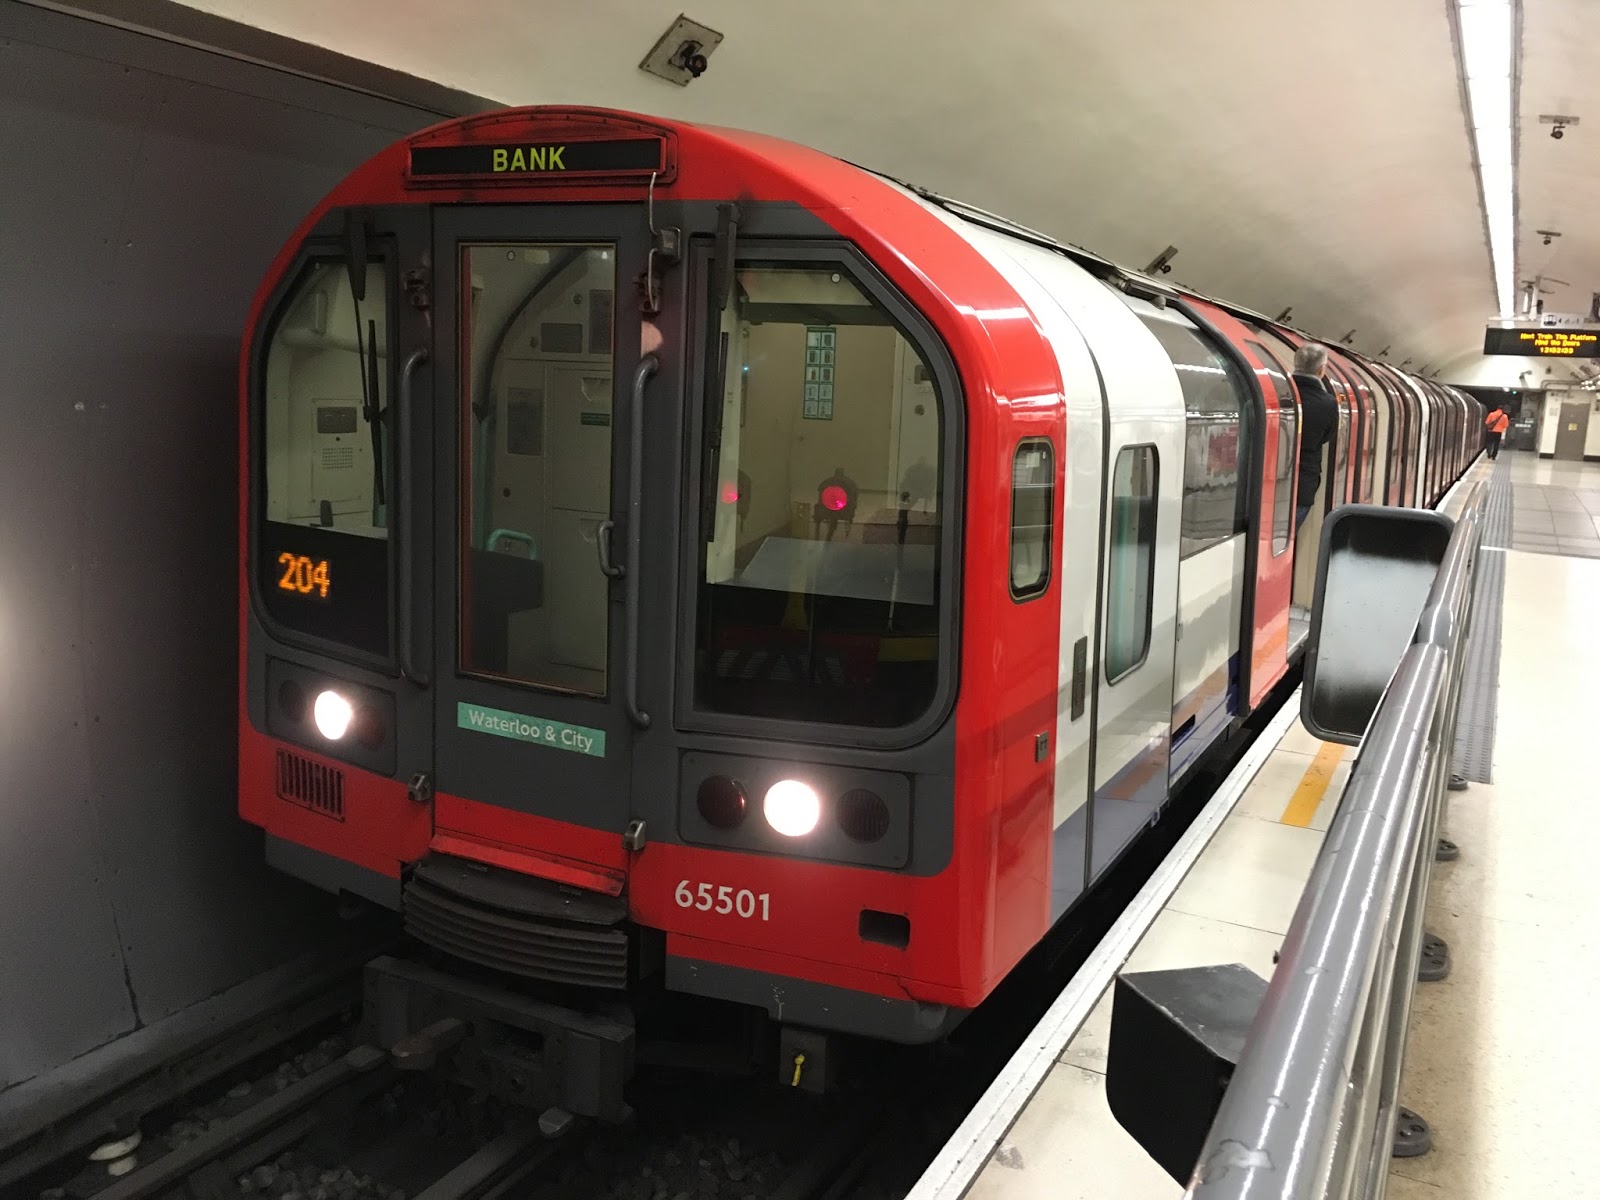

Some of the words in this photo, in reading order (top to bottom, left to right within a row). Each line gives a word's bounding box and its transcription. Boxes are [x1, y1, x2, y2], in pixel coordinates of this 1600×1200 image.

[493, 146, 566, 171] BANK
[278, 552, 330, 598] 204
[468, 709, 540, 738] Waterloo
[545, 725, 556, 741] &
[561, 729, 593, 752] City
[674, 880, 770, 921] 65501
